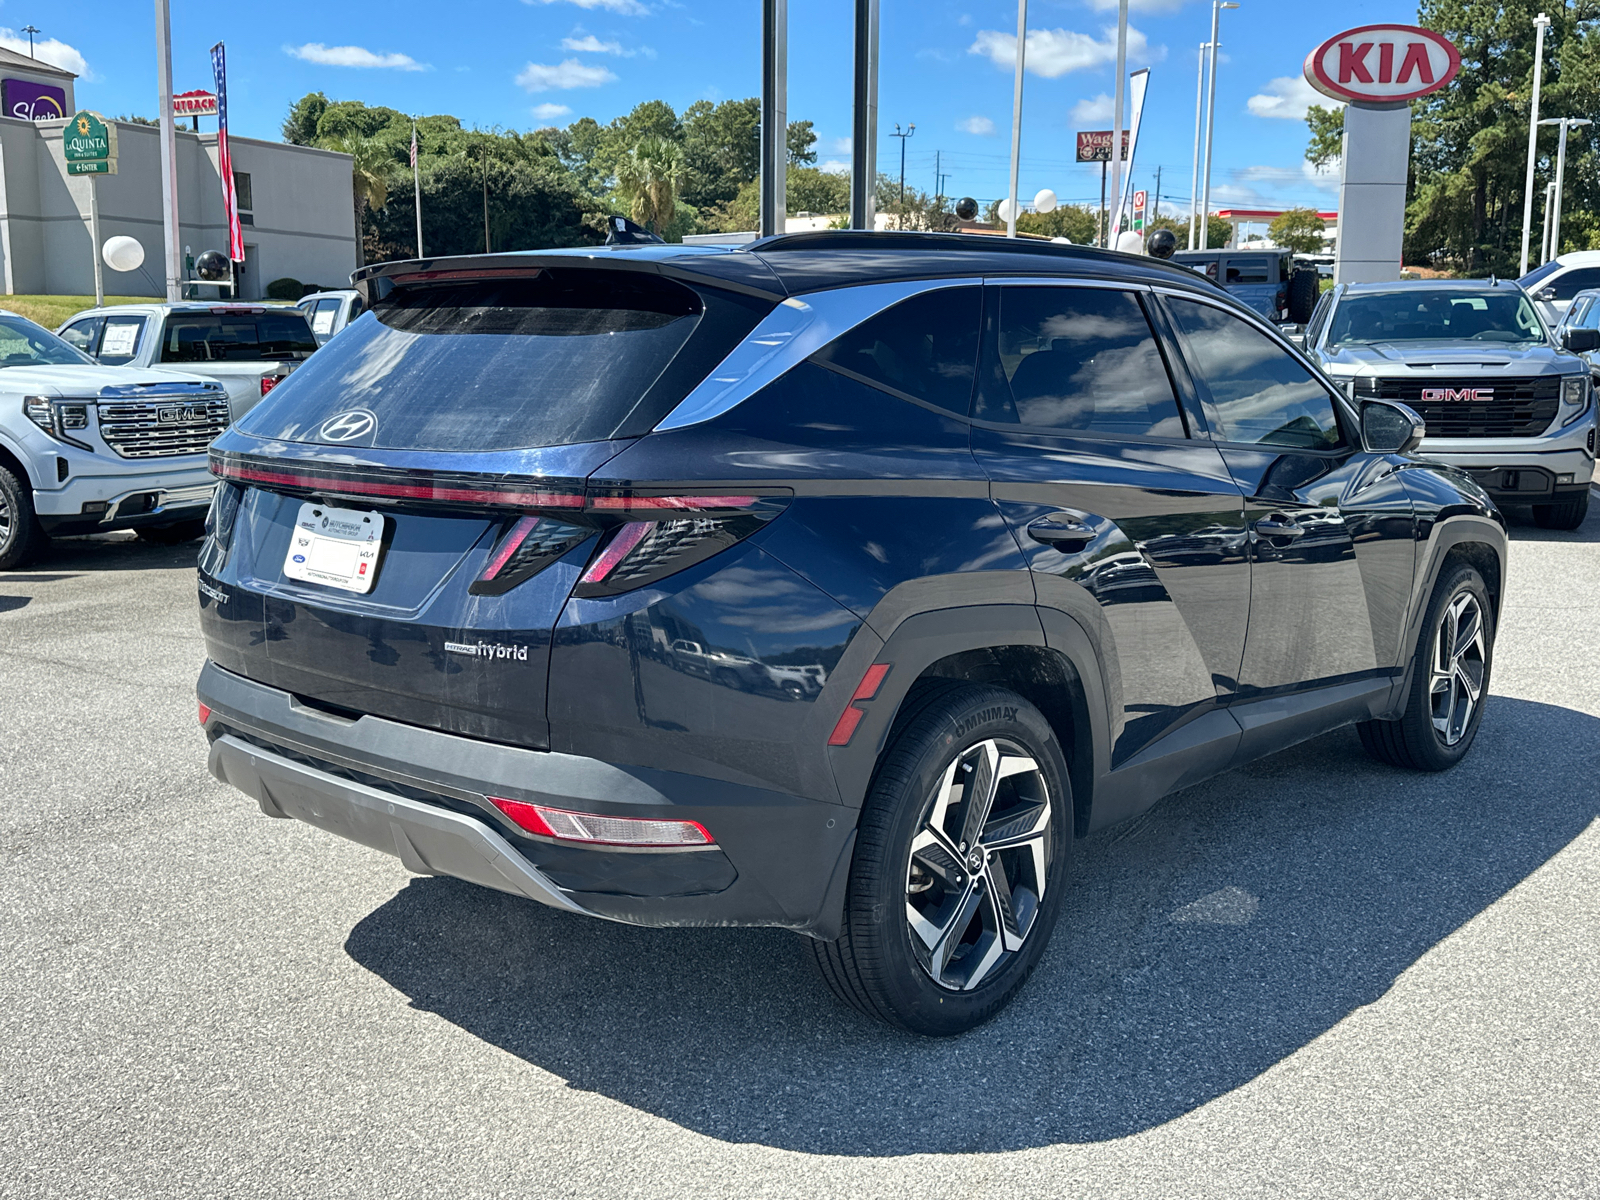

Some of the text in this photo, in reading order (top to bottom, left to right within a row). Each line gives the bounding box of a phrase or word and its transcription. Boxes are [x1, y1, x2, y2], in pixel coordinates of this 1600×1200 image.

[1339, 43, 1434, 83] KIA
[173, 98, 215, 111] UTBACK
[71, 137, 106, 152] QUINTA
[81, 163, 98, 171] ENTER
[1421, 388, 1494, 401] GMC
[160, 407, 206, 421] GMC
[478, 640, 528, 661] hybrid
[955, 706, 1019, 738] OMNIMAX
